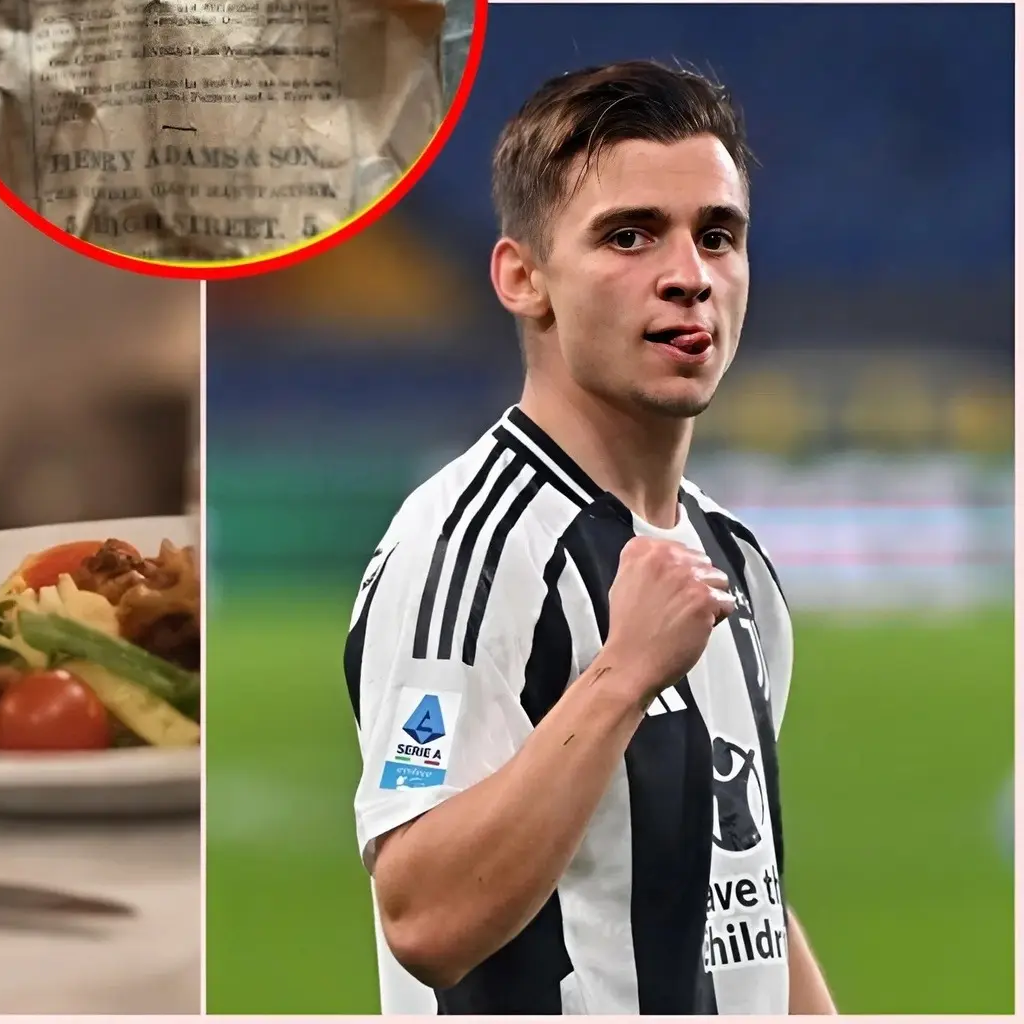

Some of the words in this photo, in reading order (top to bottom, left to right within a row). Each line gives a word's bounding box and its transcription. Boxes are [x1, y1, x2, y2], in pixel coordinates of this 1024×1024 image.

[50, 149, 136, 174] HENRY
[145, 145, 239, 169] ADAMS
[396, 743, 432, 759] SERIE
[432, 749, 442, 760] A
[704, 918, 787, 966] hildr
